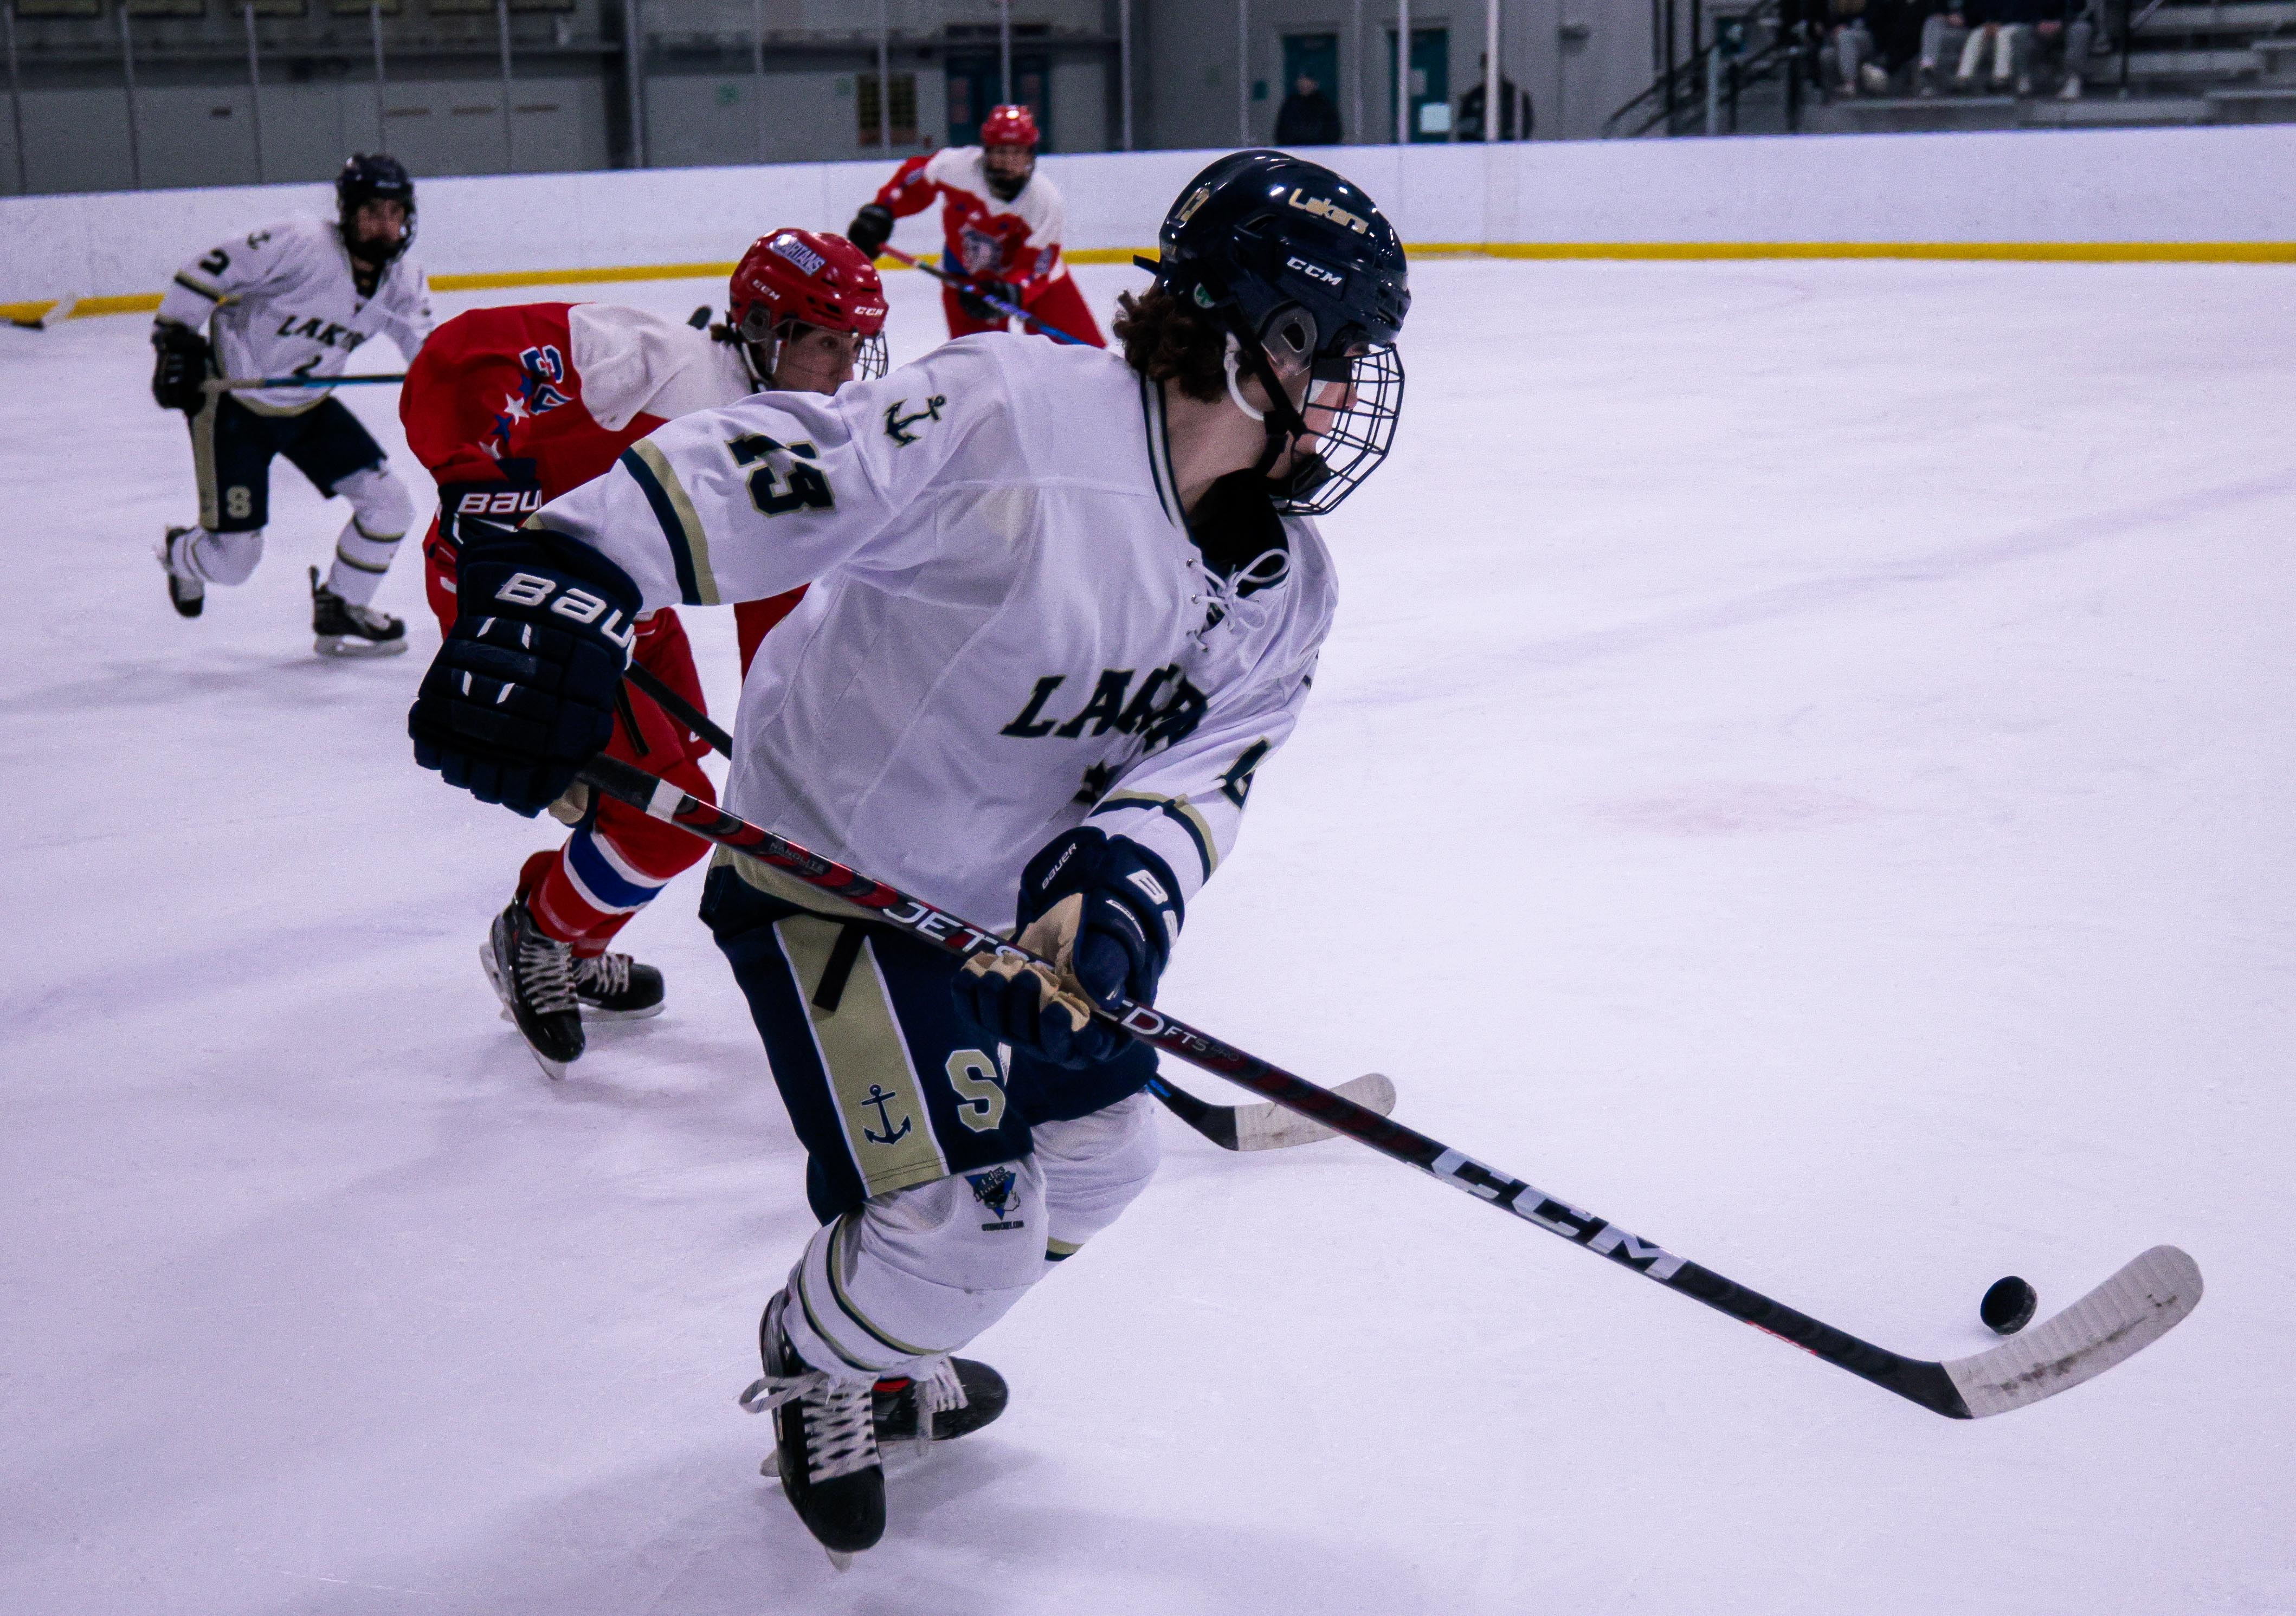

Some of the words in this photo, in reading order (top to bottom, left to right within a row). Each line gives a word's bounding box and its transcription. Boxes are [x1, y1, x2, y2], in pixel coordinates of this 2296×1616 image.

[752, 278, 781, 300] CCM
[1286, 256, 1343, 286] CCM
[854, 305, 884, 316] CCM
[724, 434, 835, 518] 13
[945, 1049, 1006, 1133] S
[1431, 1147, 1689, 1281] CCM
